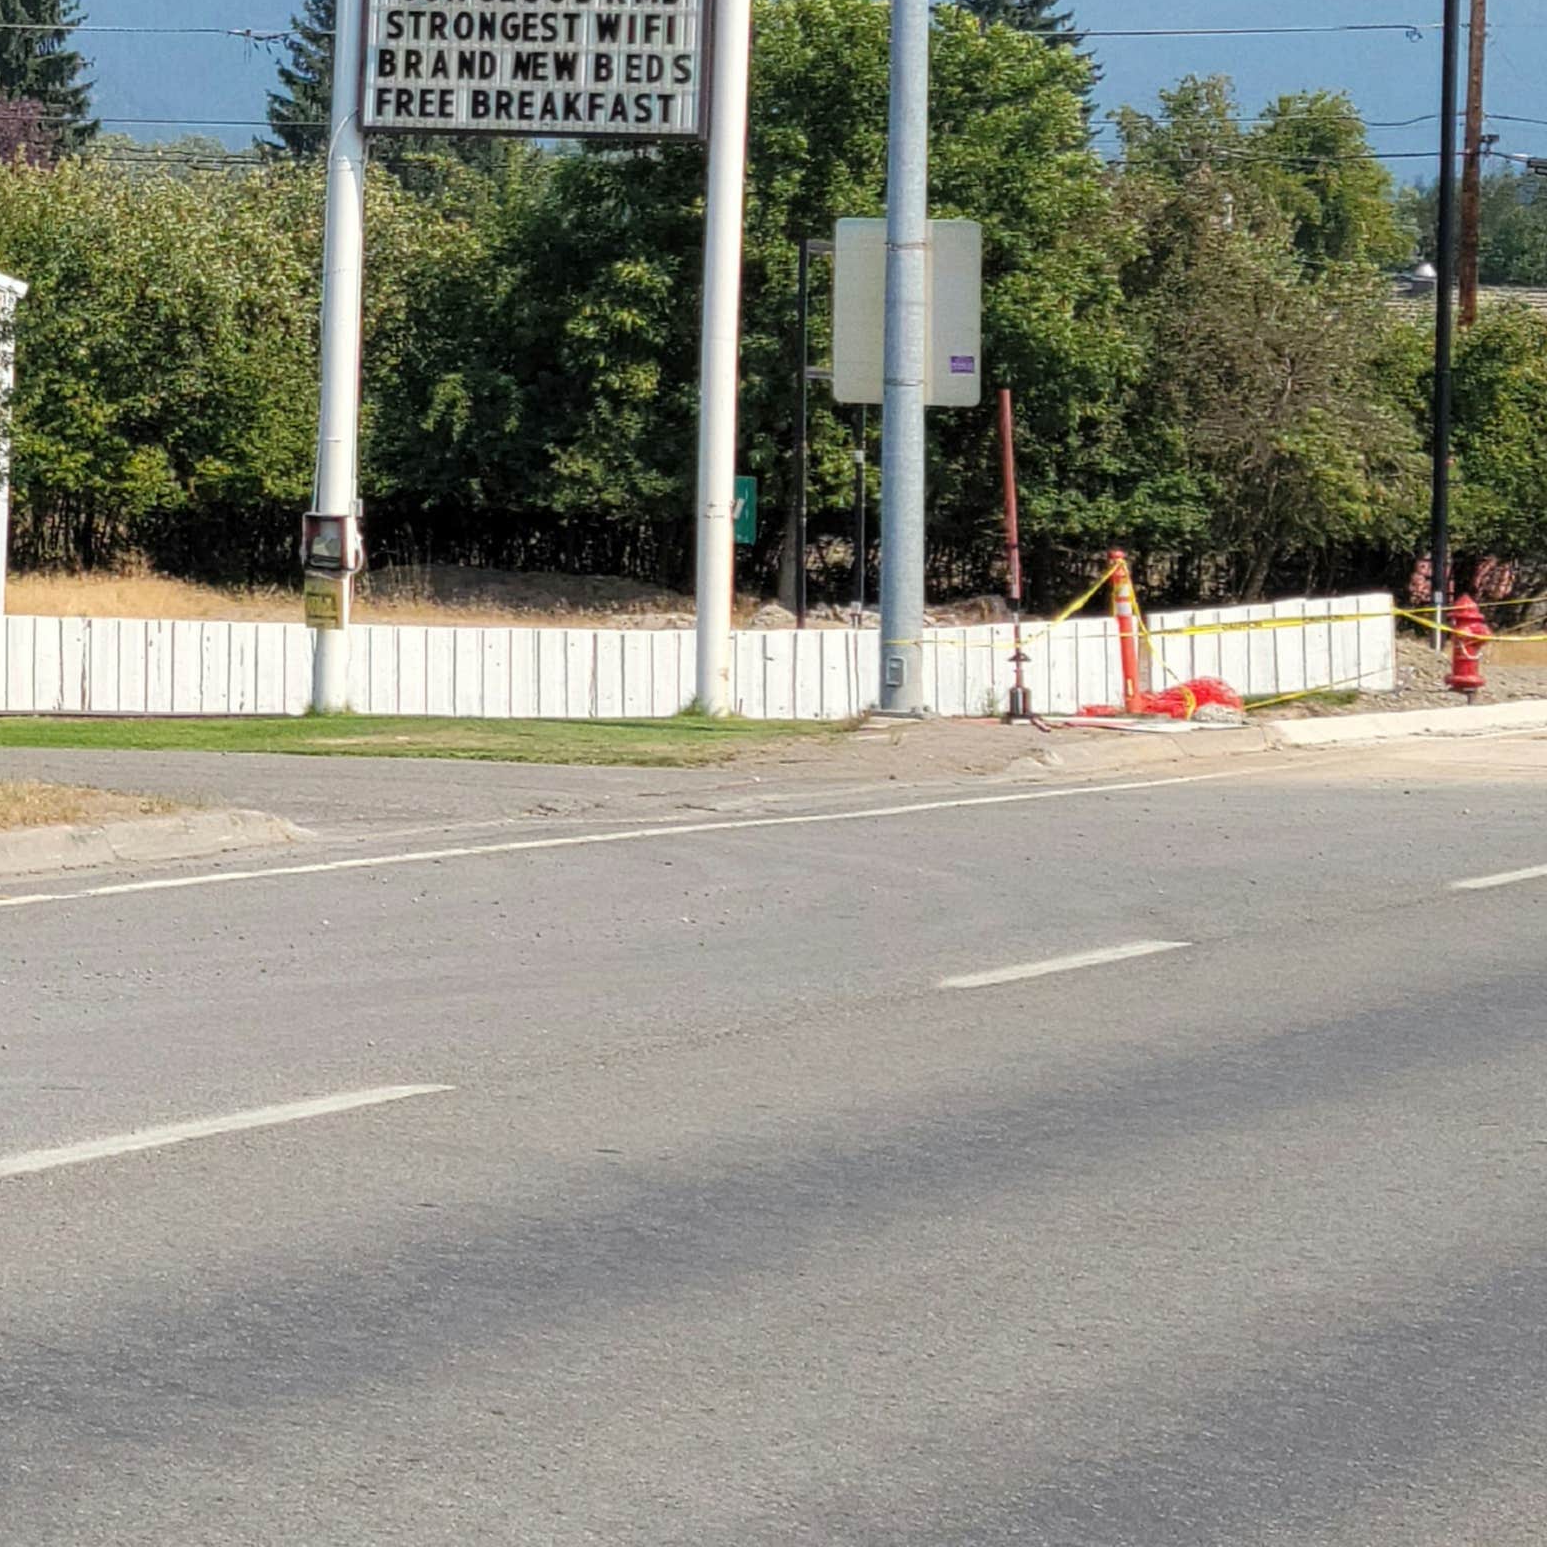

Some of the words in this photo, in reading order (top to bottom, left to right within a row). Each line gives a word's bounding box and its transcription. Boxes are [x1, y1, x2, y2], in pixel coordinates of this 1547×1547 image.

[386, 10, 582, 43] STRONGEST
[596, 13, 676, 44] WIFI
[378, 49, 497, 80] BRAND
[511, 51, 578, 81] NEW
[593, 53, 692, 83] BEDS
[375, 88, 455, 118] FREE
[470, 89, 676, 124] BREAKFAST
